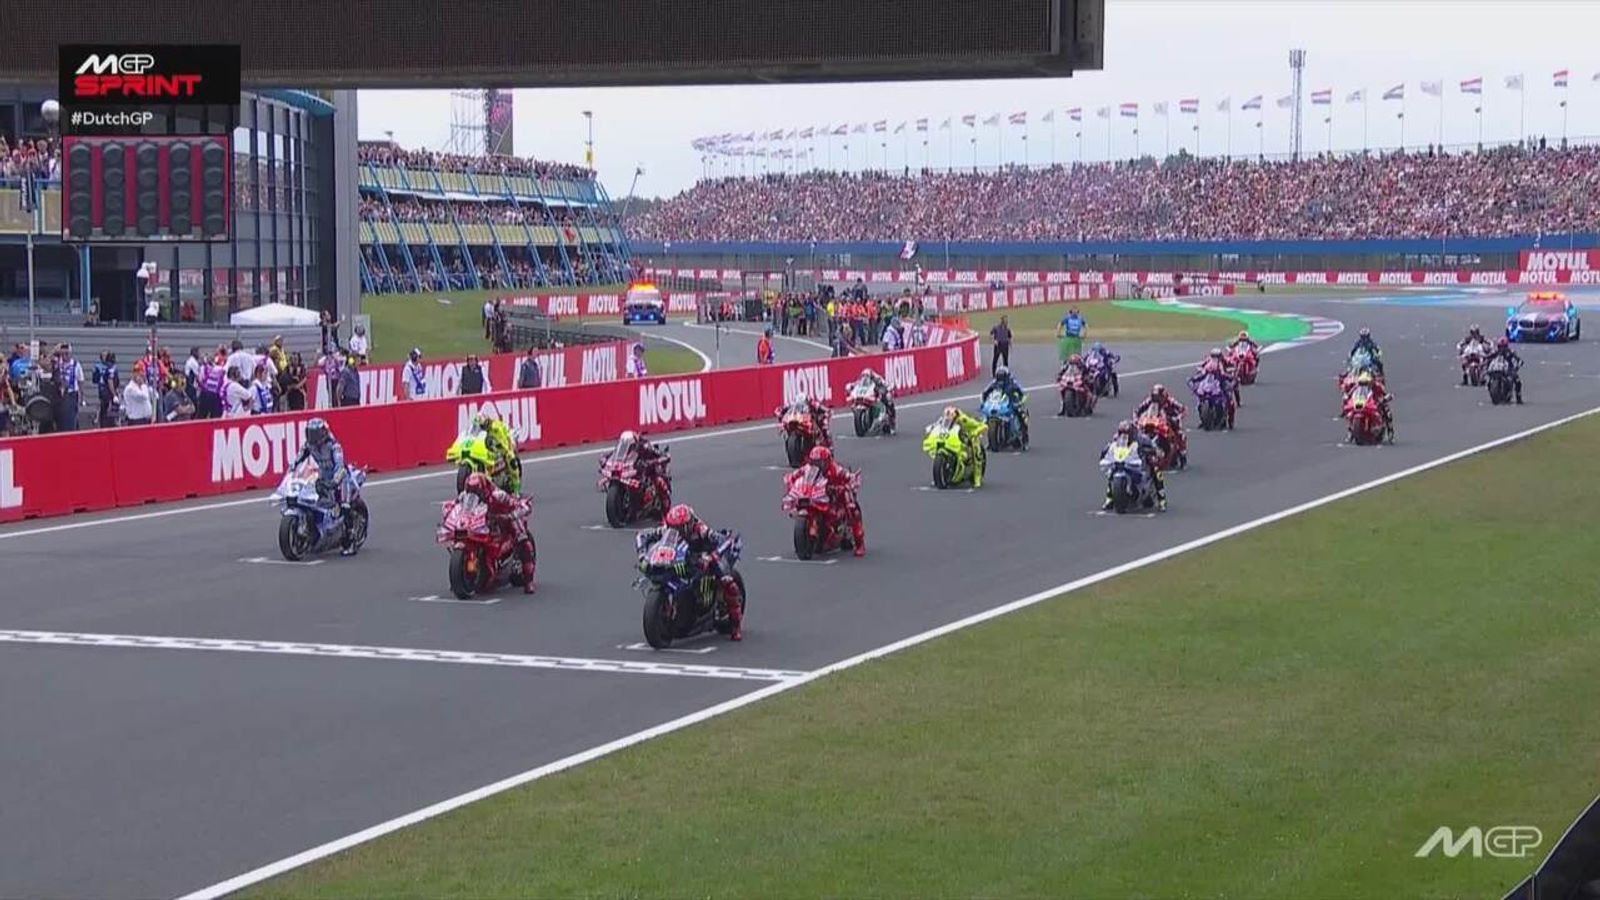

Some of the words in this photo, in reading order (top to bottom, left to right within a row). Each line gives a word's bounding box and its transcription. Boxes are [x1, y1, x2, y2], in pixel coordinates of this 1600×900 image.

[1527, 251, 1589, 271] MOTUL
[1257, 272, 1286, 284] MOTUL
[1296, 272, 1327, 284] MOTUL
[1337, 272, 1368, 284] MOTUL
[1379, 272, 1412, 284] MOTUL
[1423, 272, 1459, 284] MOTUL
[1470, 272, 1507, 284] MOTUL
[1518, 271, 1557, 284] MOTUL
[1570, 270, 1600, 283] MOT
[547, 295, 579, 315] MOTUL
[587, 294, 619, 314] MOTUL
[669, 293, 697, 312] MOTUL
[512, 353, 567, 391] MTUL
[581, 346, 617, 384] MOTUL
[884, 356, 918, 390] MOTUL
[315, 368, 398, 411] MTUL
[783, 365, 832, 408] MOTUL
[639, 379, 706, 425] MOTUL
[211, 420, 308, 483] MOTU
